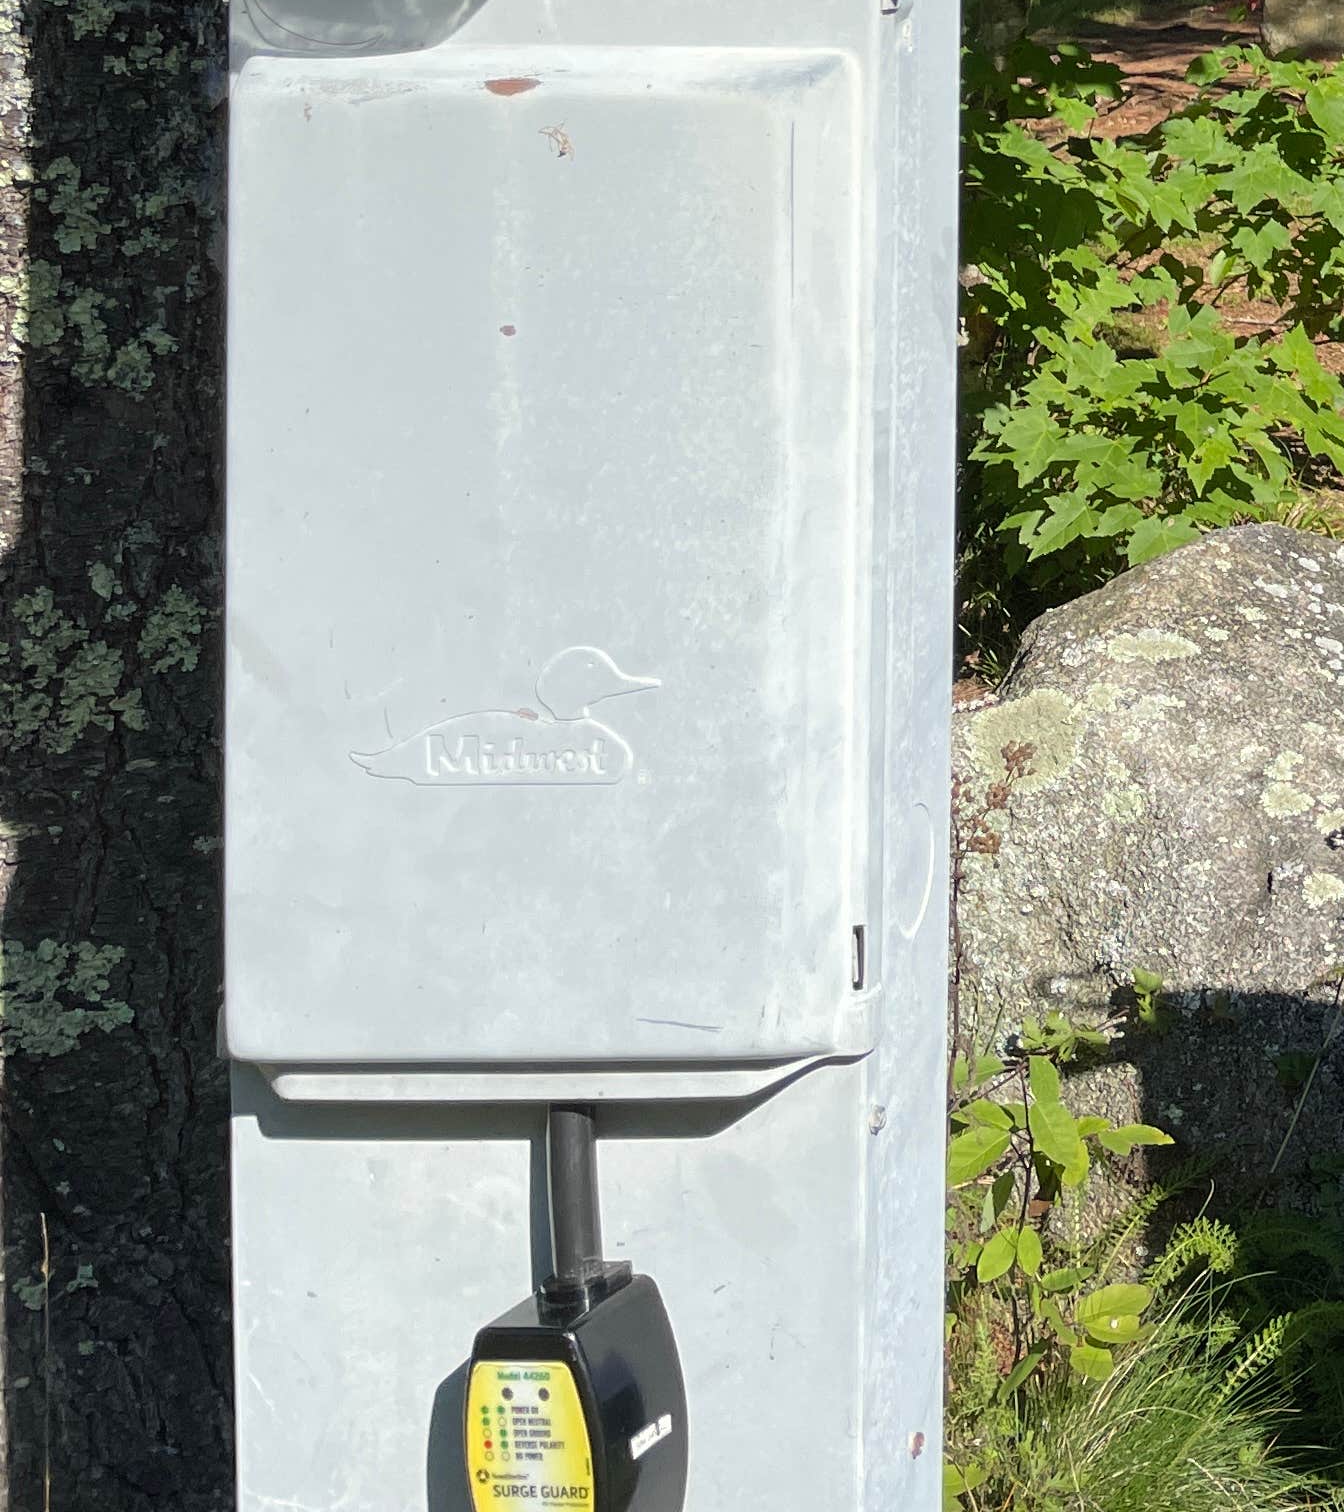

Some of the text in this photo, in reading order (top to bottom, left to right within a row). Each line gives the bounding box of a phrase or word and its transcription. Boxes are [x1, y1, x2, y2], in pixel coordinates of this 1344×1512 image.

[425, 734, 607, 776] Midwest
[493, 1484, 589, 1500] SURGE GUARD
